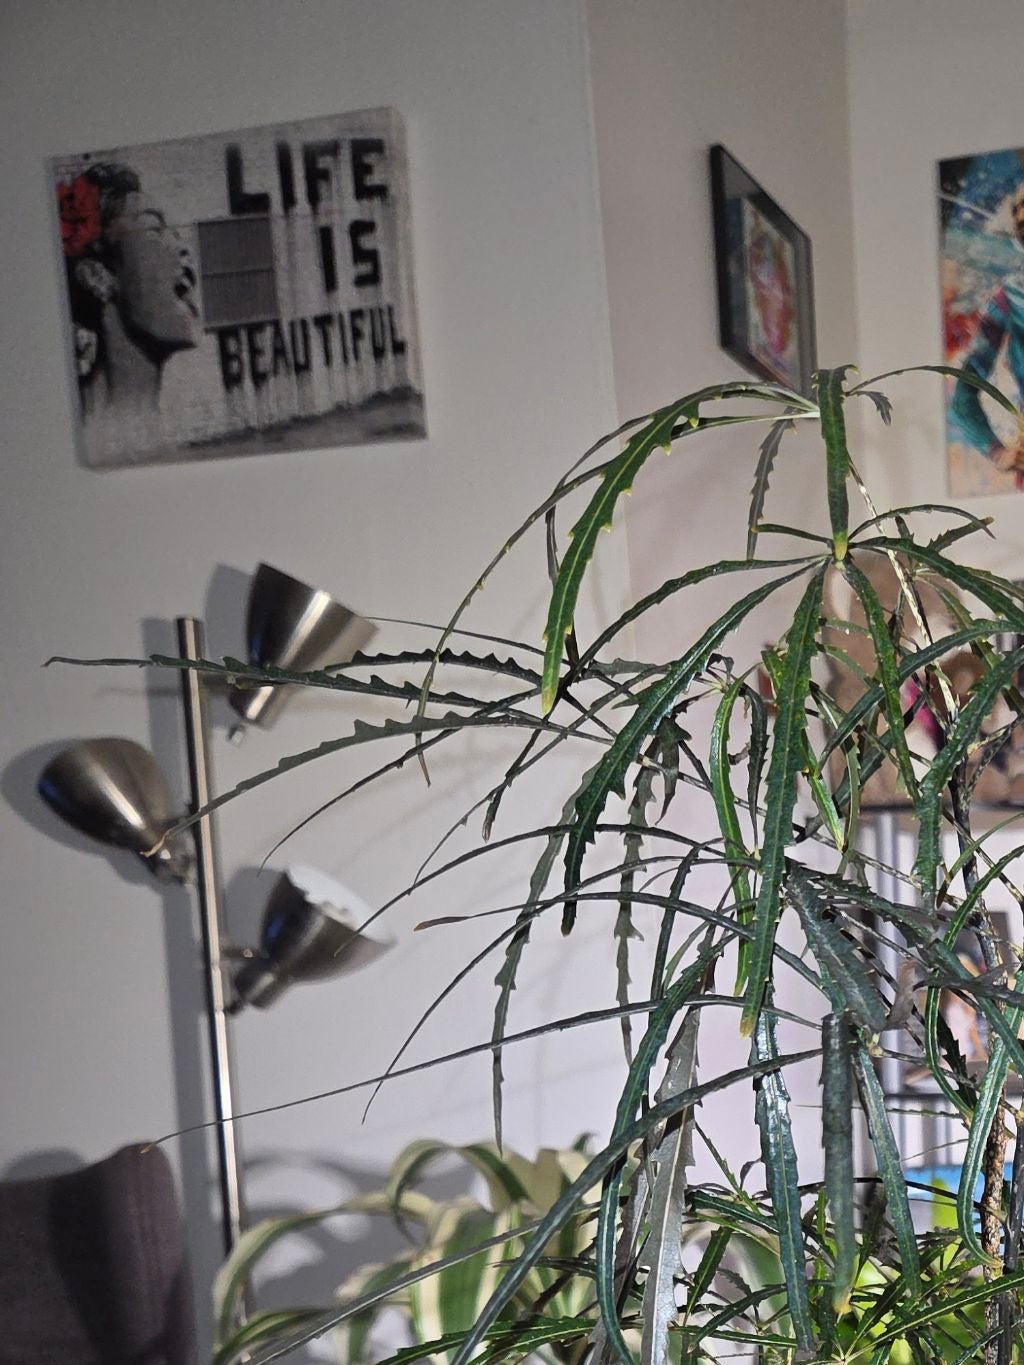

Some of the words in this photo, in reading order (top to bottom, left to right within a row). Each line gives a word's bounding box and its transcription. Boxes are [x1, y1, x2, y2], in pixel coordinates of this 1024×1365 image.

[226, 138, 388, 215] LIFE
[320, 219, 381, 293] IS
[217, 306, 406, 392] BEAUTIFUL
